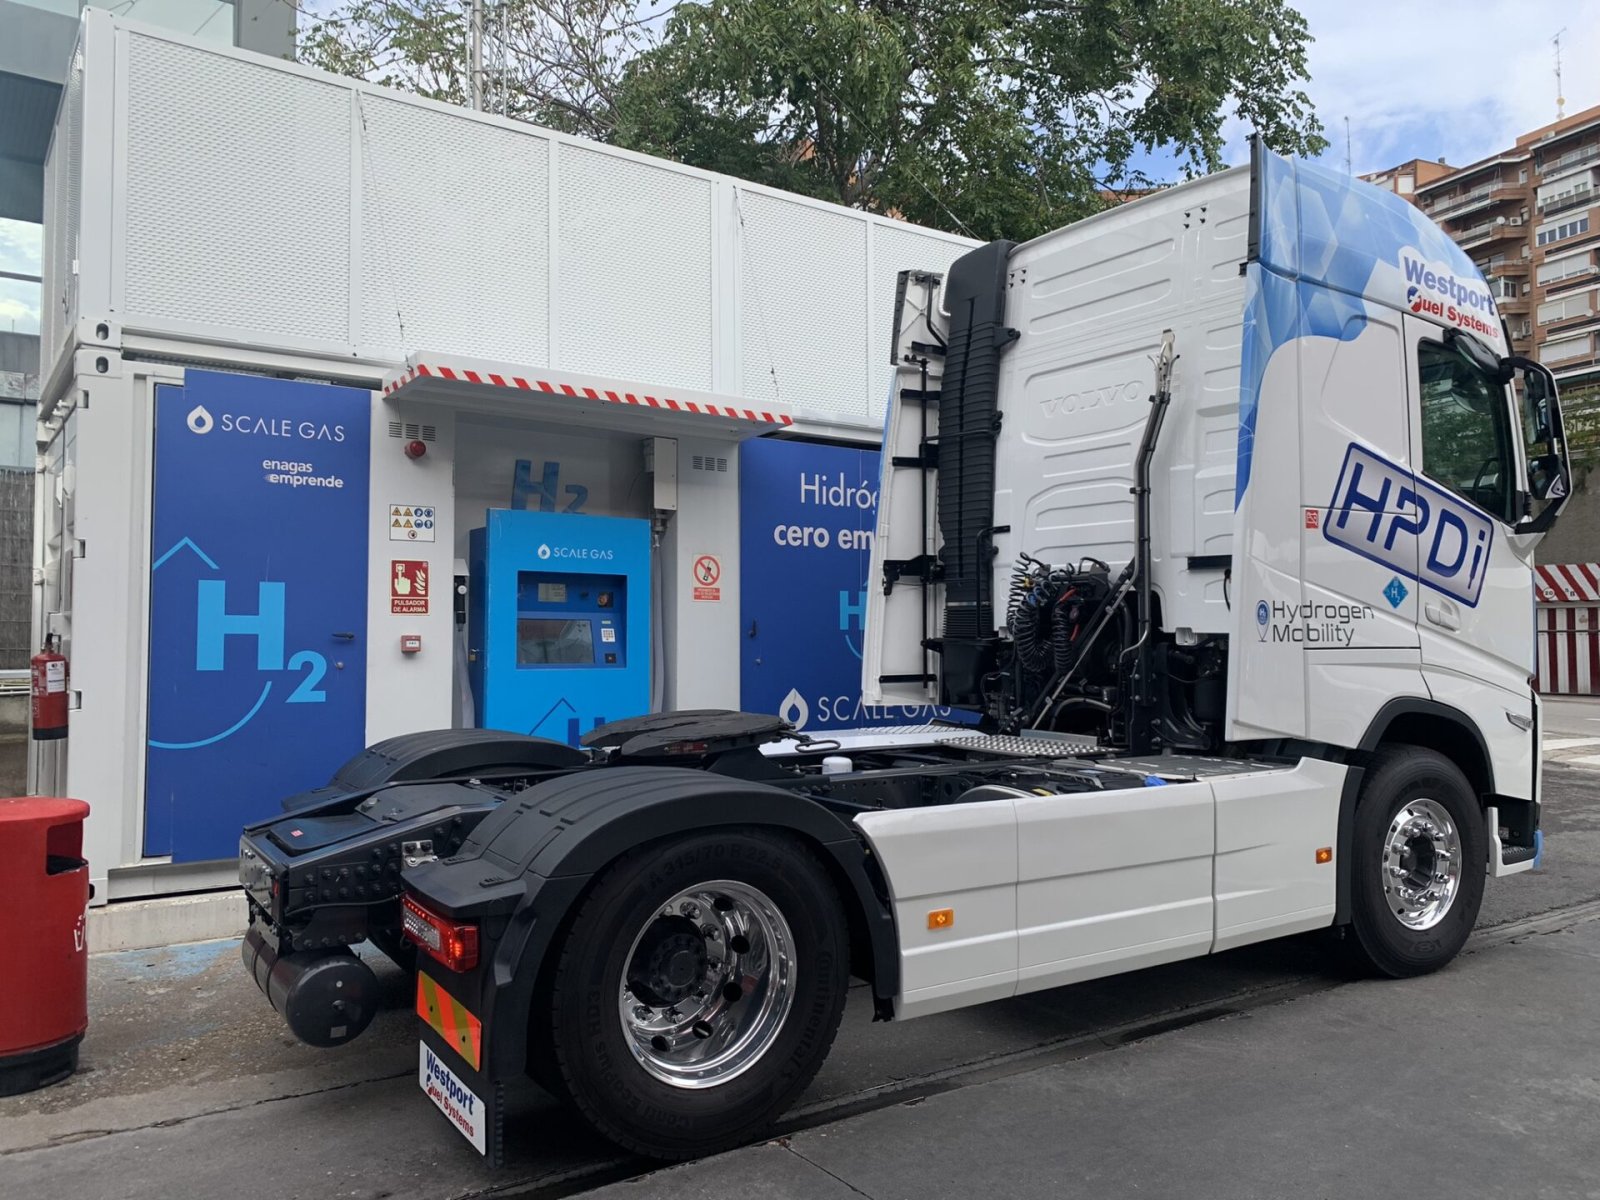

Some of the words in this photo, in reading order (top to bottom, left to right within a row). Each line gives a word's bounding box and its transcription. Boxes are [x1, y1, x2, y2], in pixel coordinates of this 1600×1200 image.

[1404, 256, 1495, 316] Westport
[1447, 305, 1499, 338] Systems
[1039, 380, 1145, 419] VOLVO
[221, 413, 292, 438] SCALE
[298, 422, 345, 442] GAS
[262, 459, 313, 475] enagas
[268, 473, 344, 488] emprende
[773, 524, 830, 549] cero
[1336, 462, 1487, 590] HPDi
[553, 547, 588, 559] SCALE
[590, 549, 614, 560] GAS
[1272, 600, 1375, 624] Hydrogen
[1272, 623, 1355, 647] Mobility
[426, 1049, 475, 1115] Westport
[443, 1097, 475, 1138] Systems
